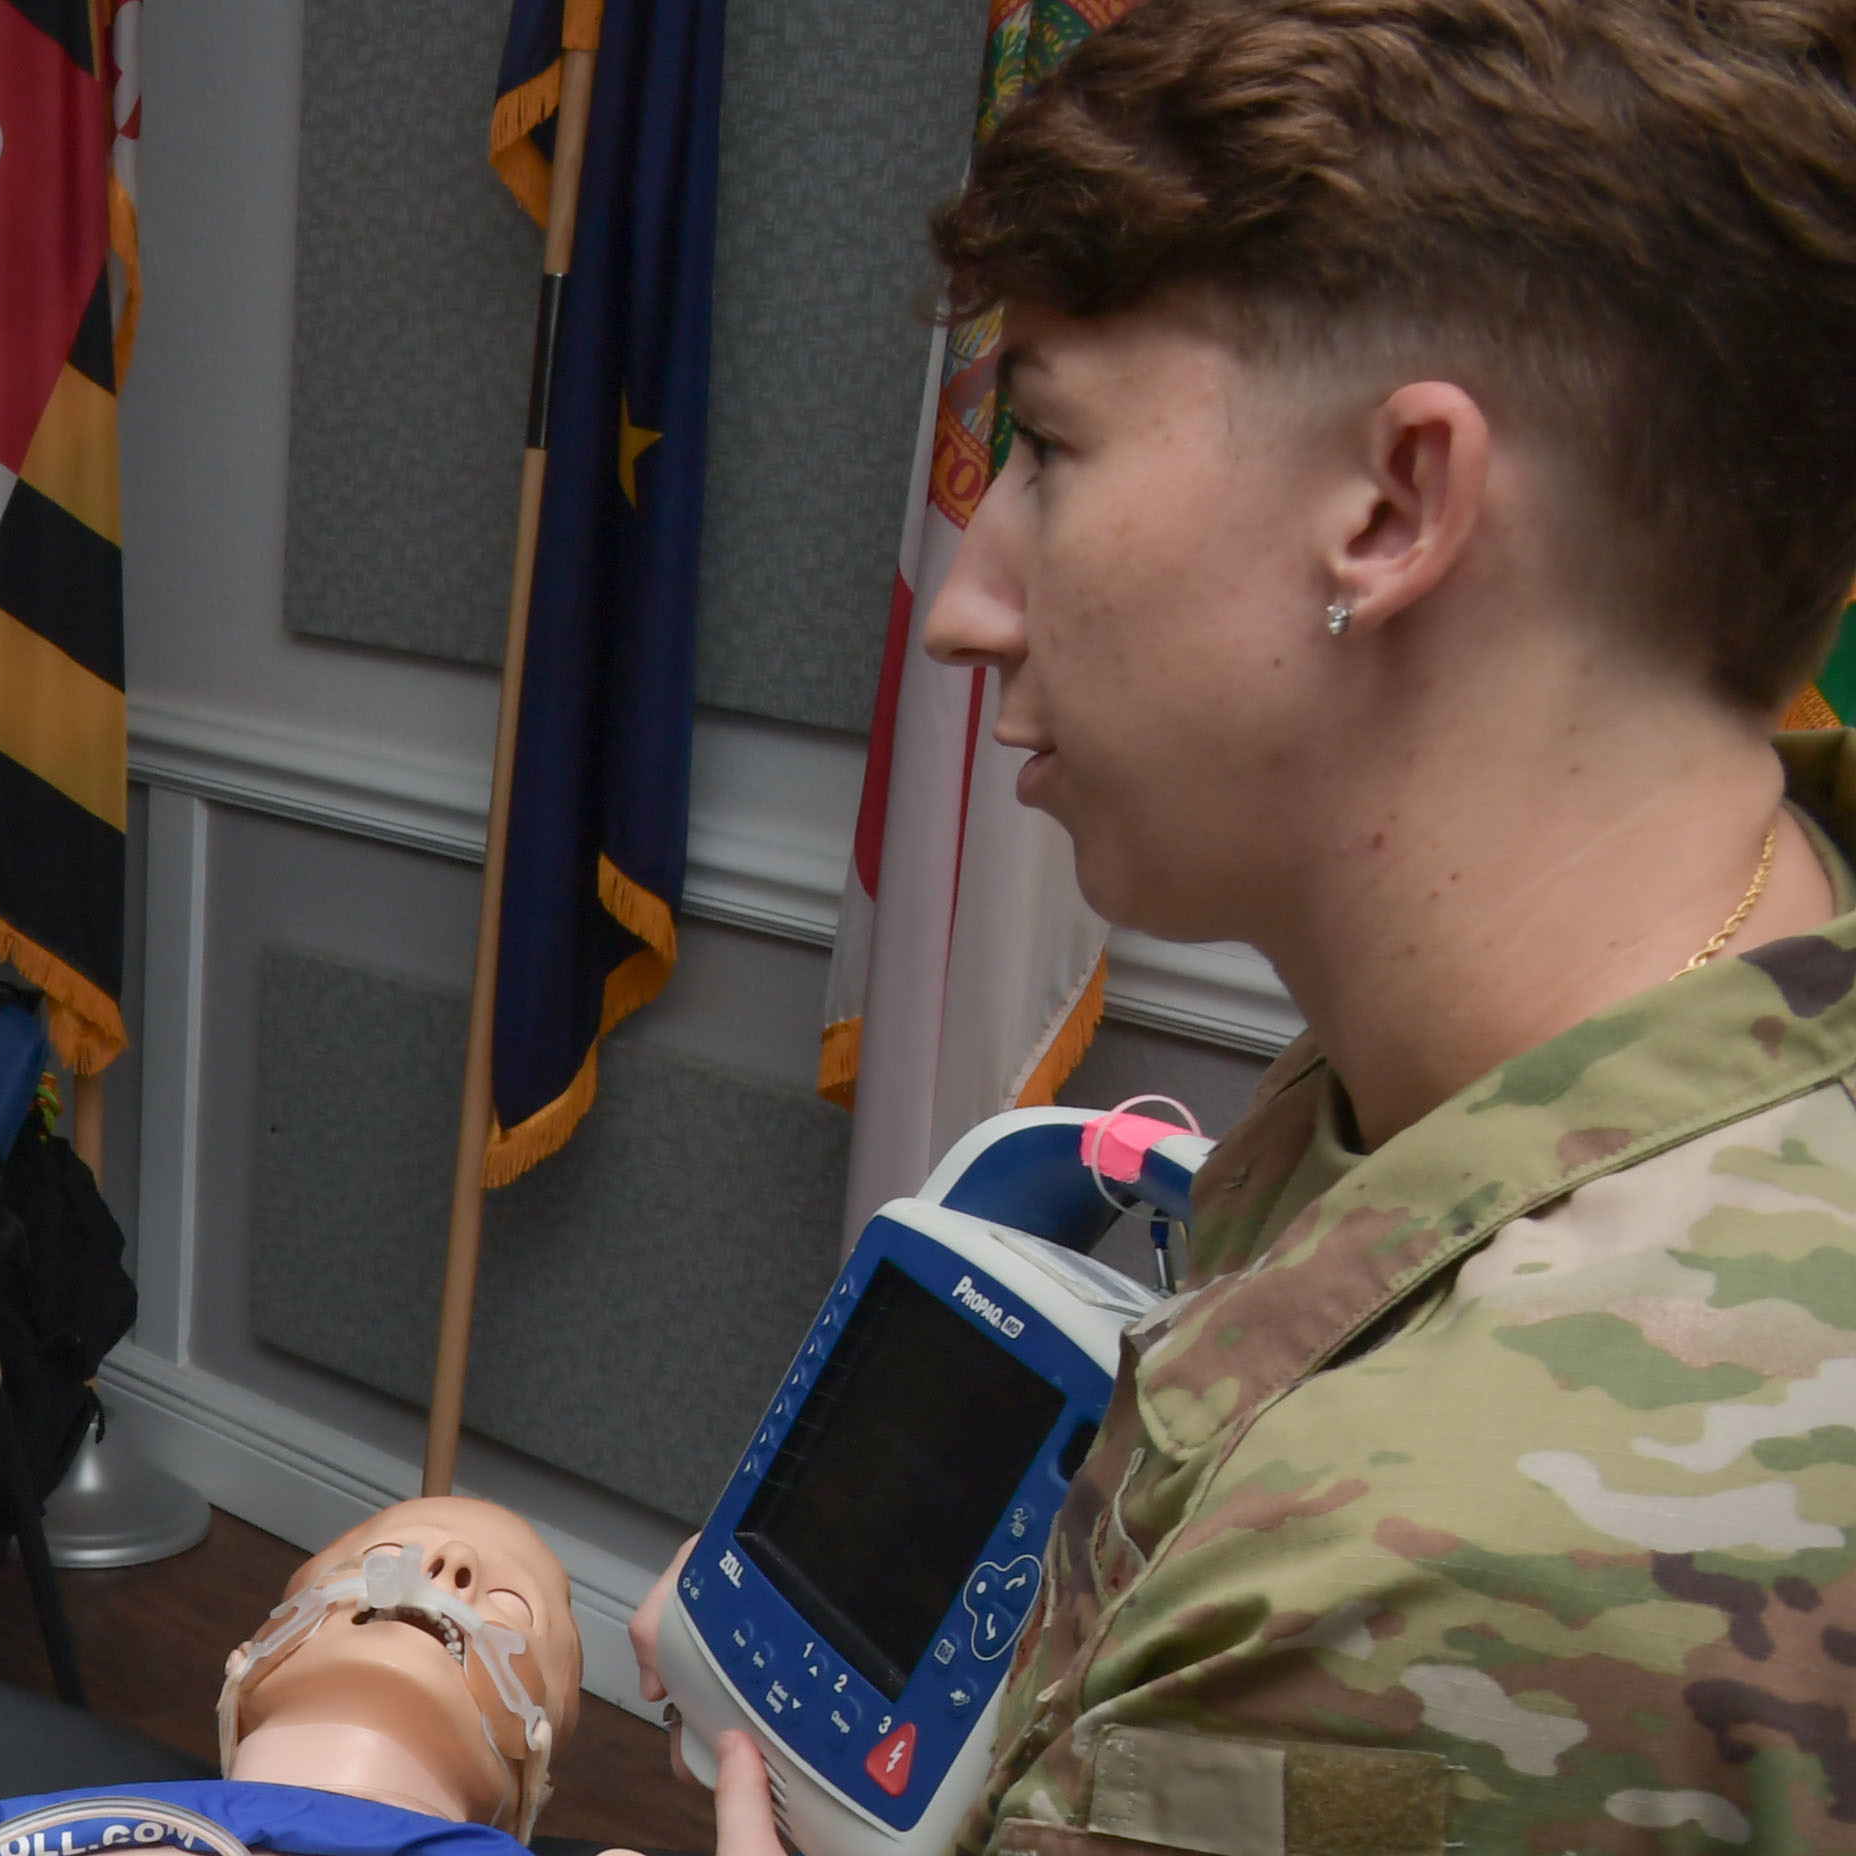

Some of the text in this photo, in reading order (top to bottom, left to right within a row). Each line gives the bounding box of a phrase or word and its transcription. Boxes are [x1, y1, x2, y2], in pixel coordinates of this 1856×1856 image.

[718, 1550, 745, 1589] ZOLL
[802, 1641, 815, 1659] 1
[833, 1673, 849, 1694] 2
[878, 1714, 892, 1735] 3
